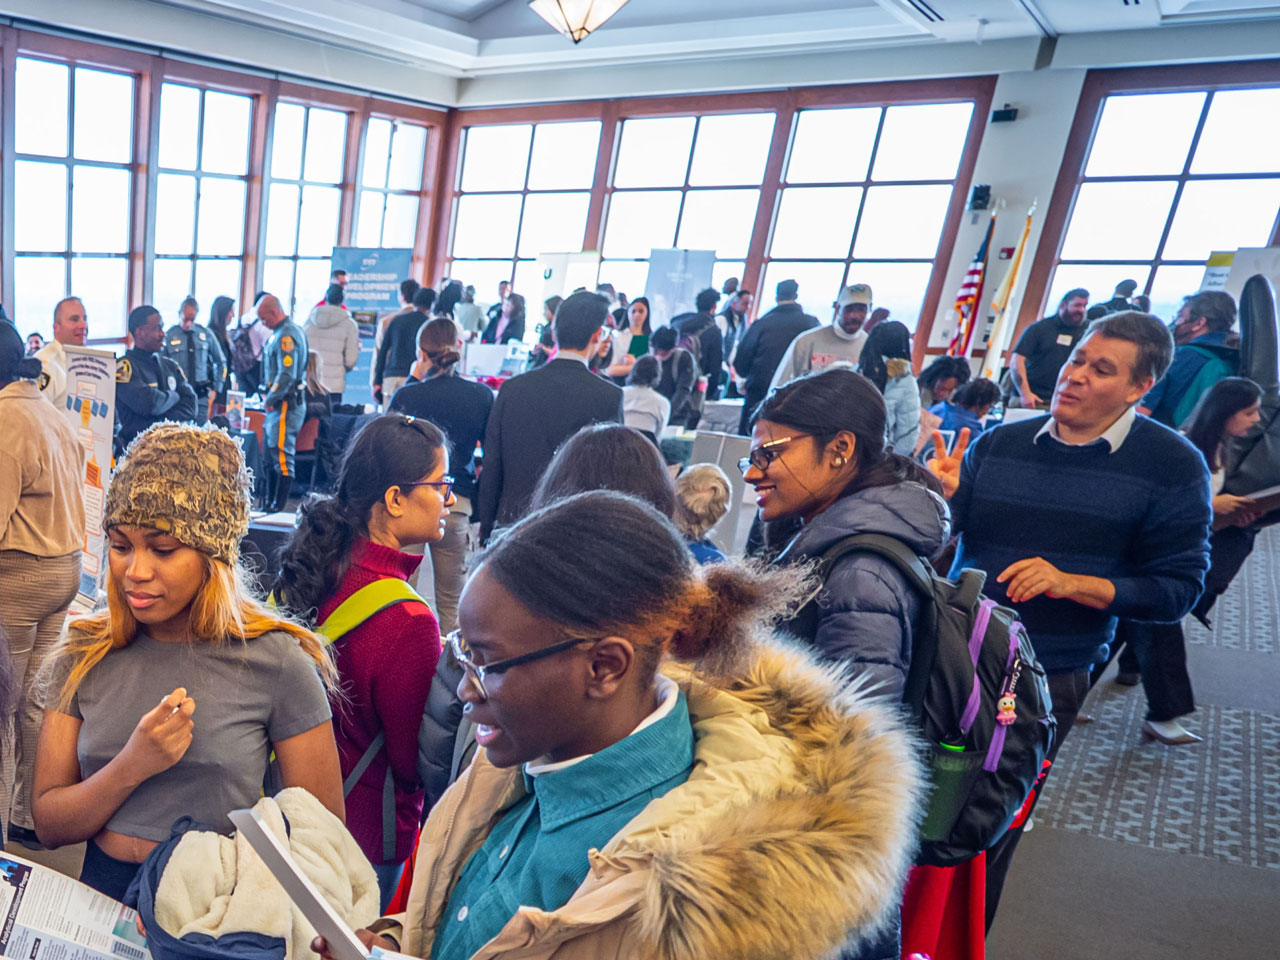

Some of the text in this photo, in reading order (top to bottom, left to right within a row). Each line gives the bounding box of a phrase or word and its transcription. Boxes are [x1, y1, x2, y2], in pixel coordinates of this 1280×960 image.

[348, 273, 398, 281] EADERSHIP
[1, 918, 15, 945] Analytical
[9, 888, 24, 918] Development
